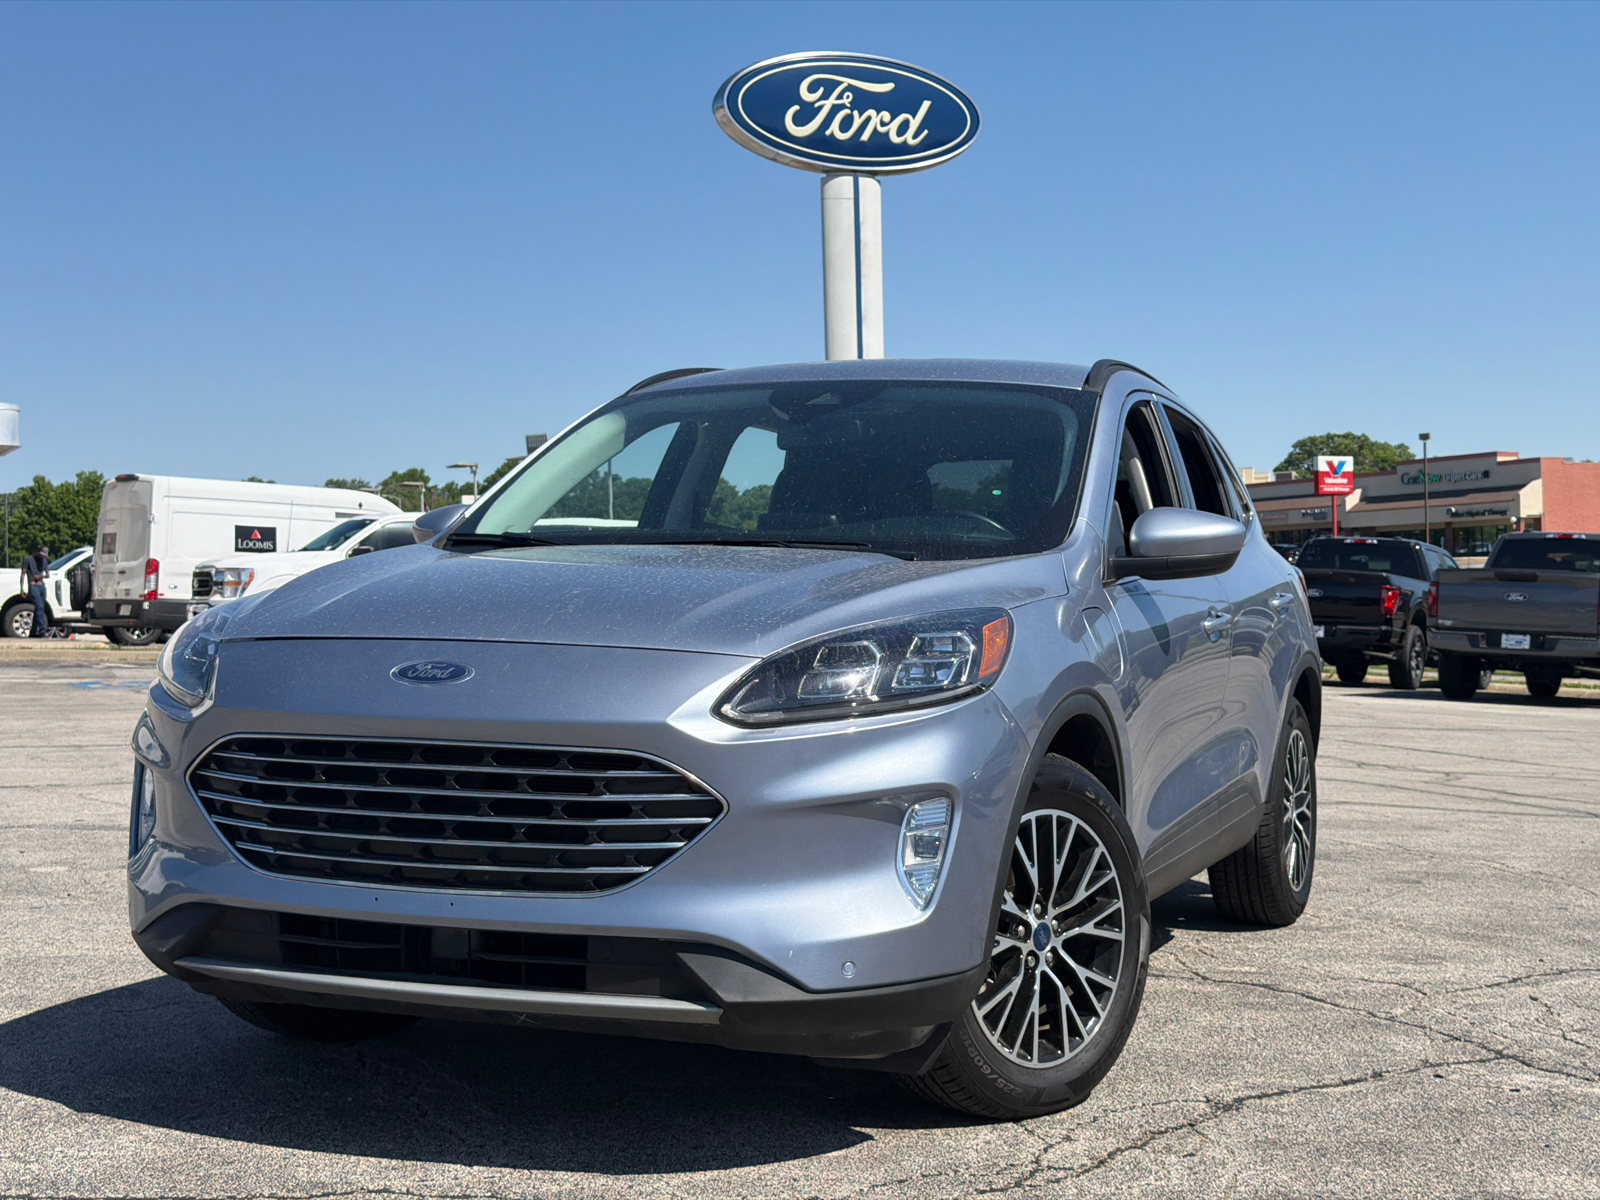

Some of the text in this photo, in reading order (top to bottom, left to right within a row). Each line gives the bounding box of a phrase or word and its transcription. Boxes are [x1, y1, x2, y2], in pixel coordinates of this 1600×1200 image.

[784, 73, 932, 146] Ford
[238, 538, 274, 550] LOOMIS
[407, 663, 456, 679] Ford
